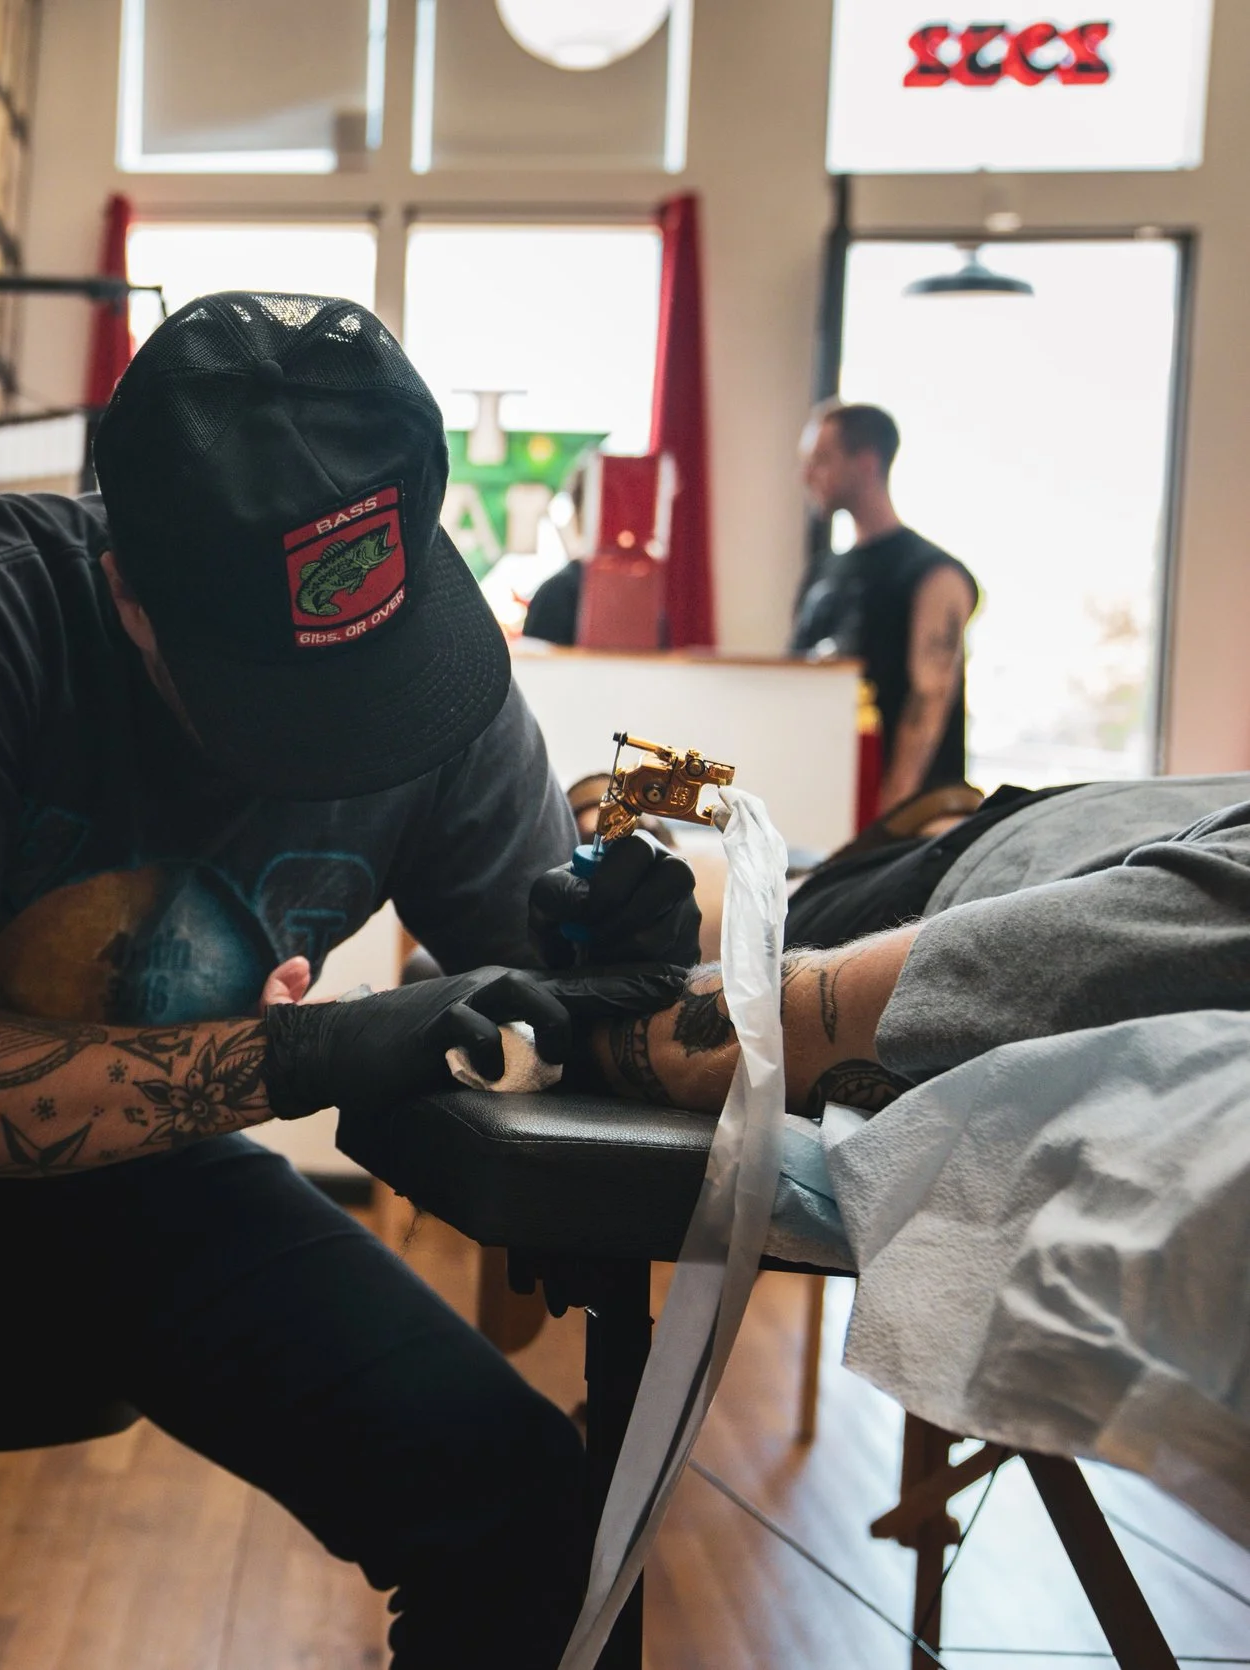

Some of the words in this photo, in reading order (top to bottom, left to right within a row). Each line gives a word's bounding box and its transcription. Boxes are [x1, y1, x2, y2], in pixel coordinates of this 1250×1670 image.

[315, 496, 378, 535] BASS
[345, 621, 368, 638] OR
[371, 589, 404, 625] OVER
